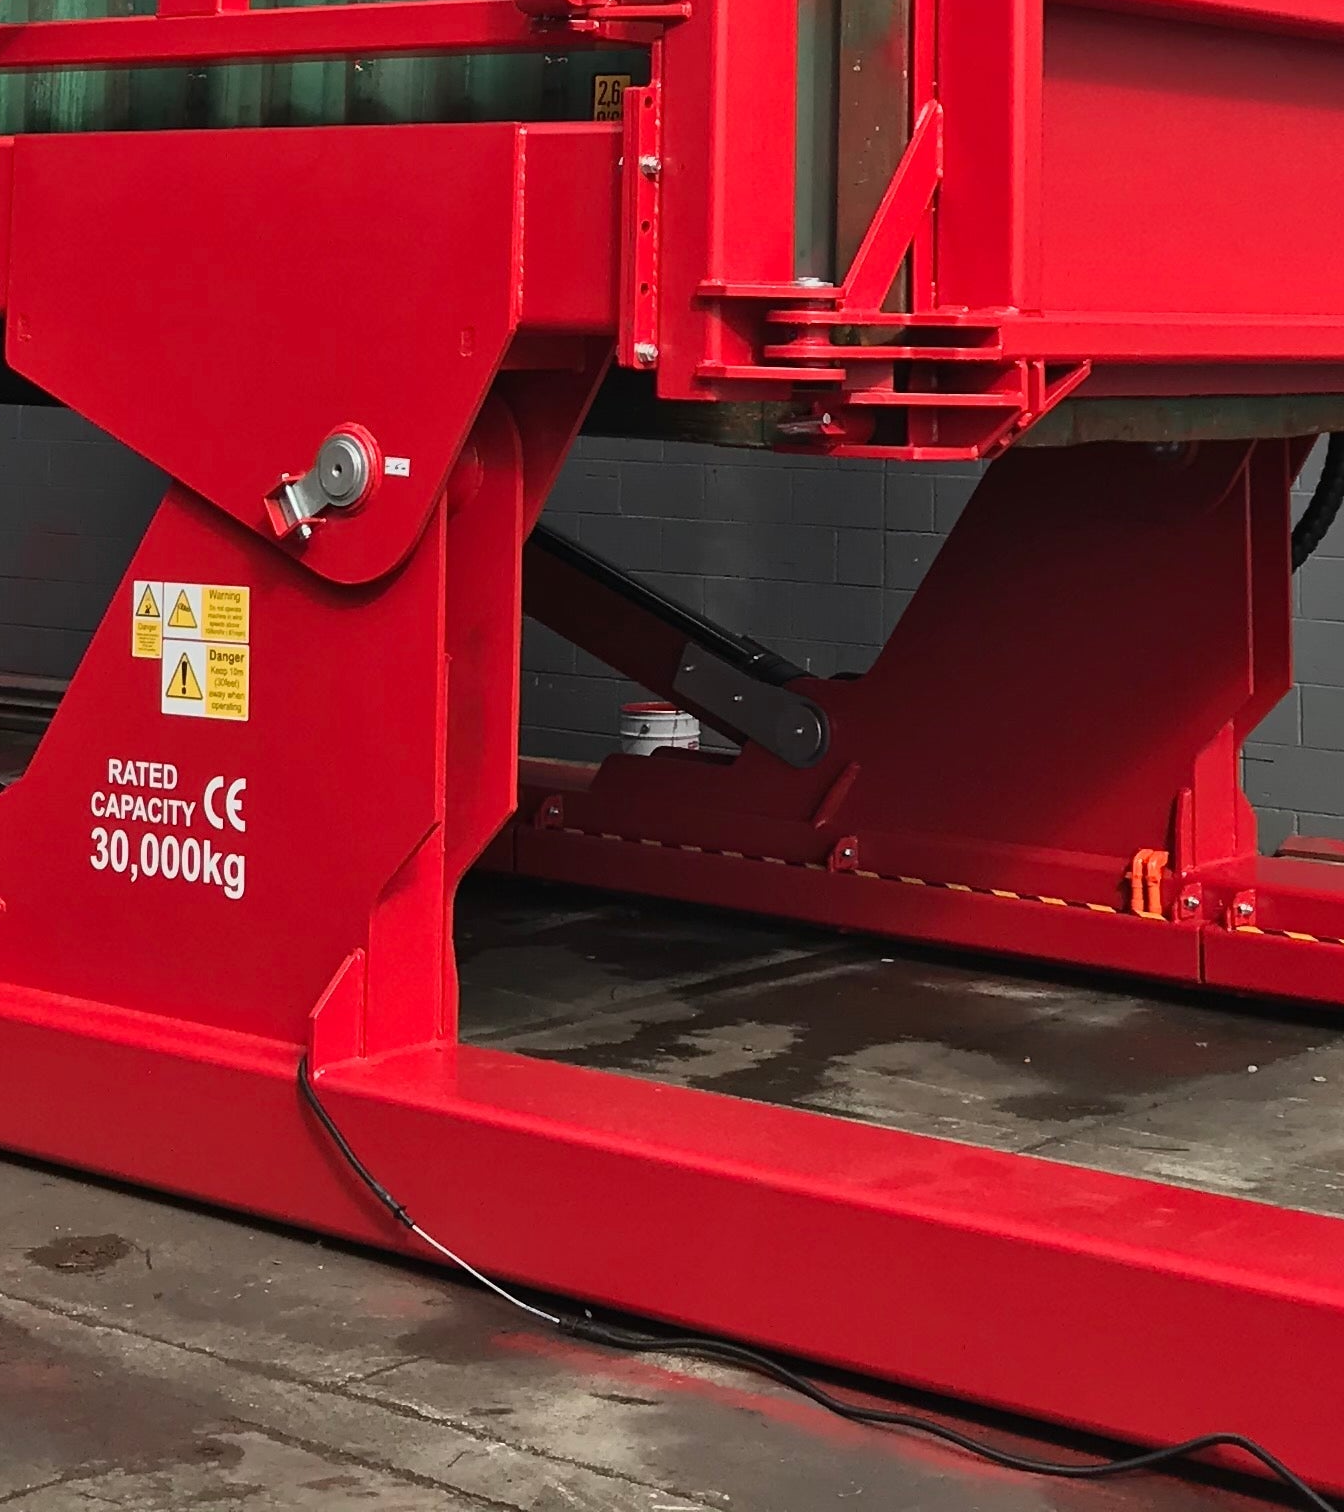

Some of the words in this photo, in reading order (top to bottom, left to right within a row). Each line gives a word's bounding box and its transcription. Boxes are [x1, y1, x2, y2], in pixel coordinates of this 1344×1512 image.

[209, 589, 240, 603] Warning
[209, 649, 244, 665] Danger
[211, 702, 242, 714] operating
[108, 758, 178, 789] RATED
[90, 791, 197, 827] CAPACITY
[203, 775, 247, 832] CE
[90, 826, 246, 900] 30,000kg
